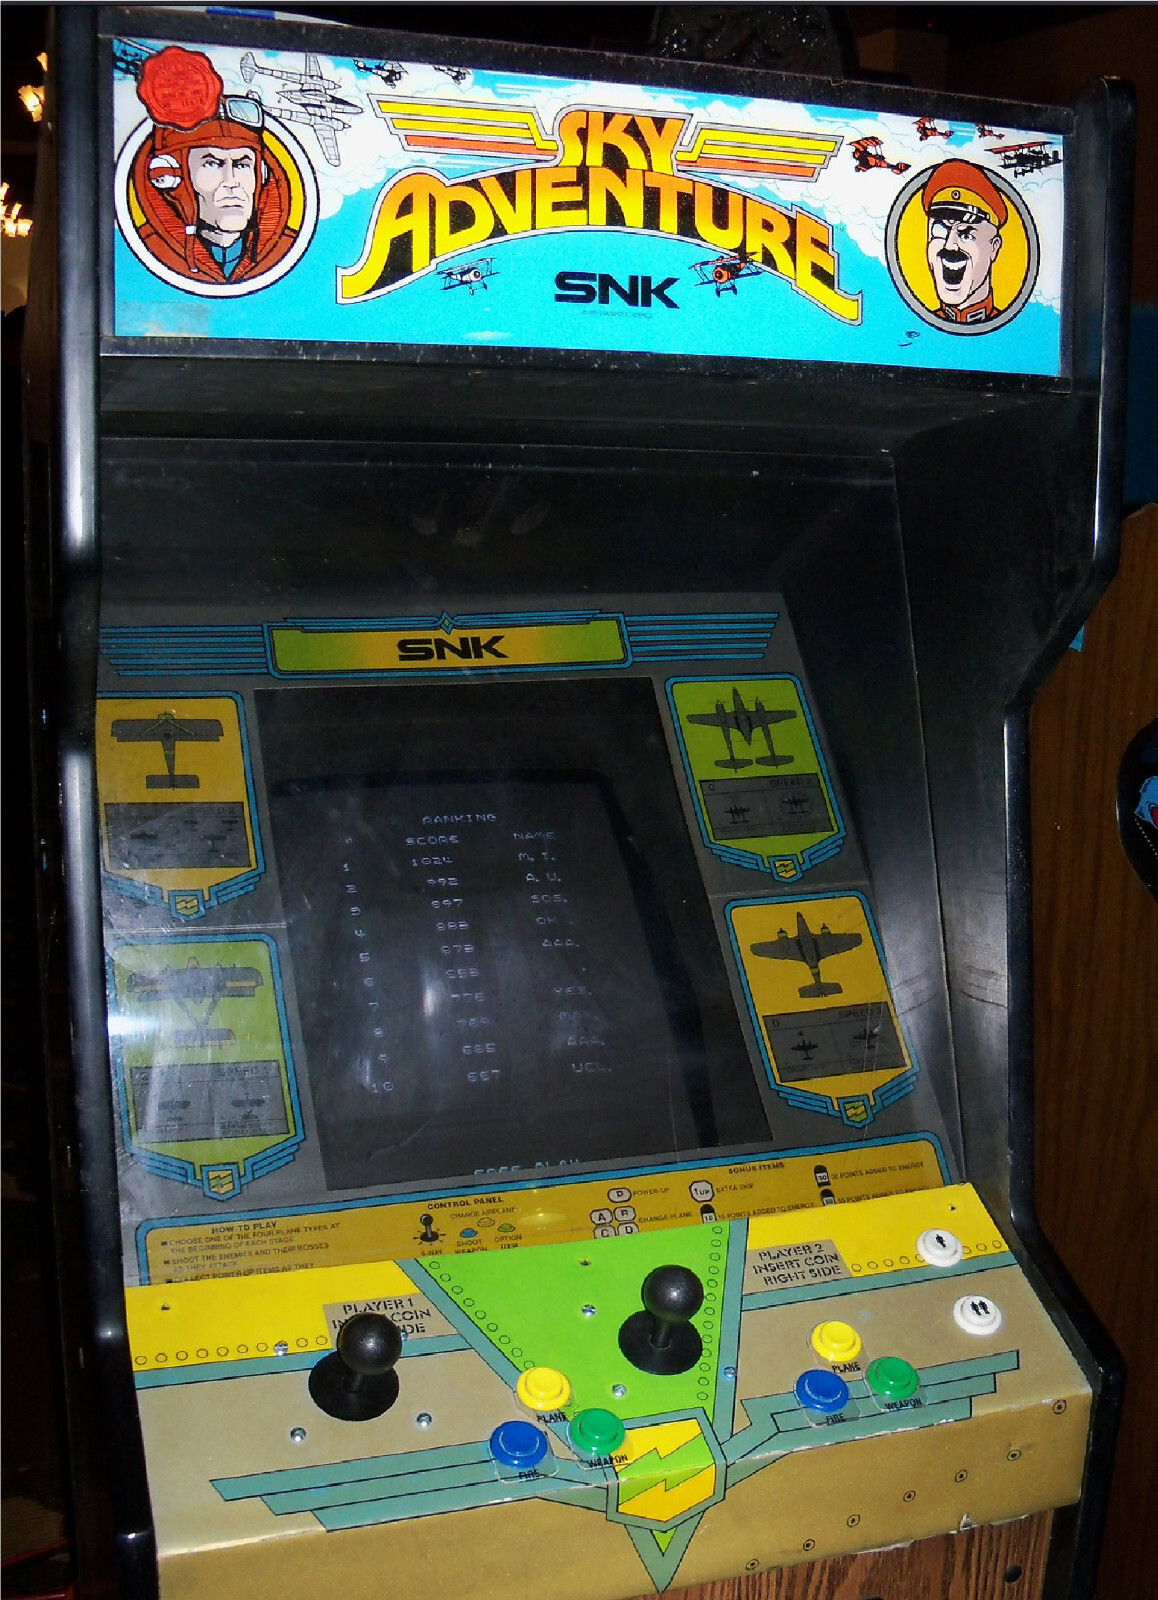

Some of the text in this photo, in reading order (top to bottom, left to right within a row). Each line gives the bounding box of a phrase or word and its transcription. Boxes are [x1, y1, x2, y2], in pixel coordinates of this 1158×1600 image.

[558, 109, 685, 176] SKY
[338, 166, 861, 324] ADVENTURE
[555, 270, 680, 309] SNK
[398, 635, 510, 662] SNK
[422, 813, 497, 825] RANKING
[404, 834, 460, 846] SCORE
[513, 831, 556, 840] NAME
[343, 862, 350, 872] 1
[345, 884, 358, 893] 2
[350, 905, 362, 917] 3
[354, 928, 365, 938] 4
[359, 952, 371, 963] 5
[363, 977, 375, 987] 6
[368, 1001, 379, 1012] 7
[728, 1162, 786, 1175] BONUS ITEMS
[840, 1170, 864, 1179] POINTS
[865, 1167, 888, 1175] ADDED
[715, 1185, 738, 1194] EXTRA
[427, 1196, 504, 1210] CONTROL PANEL
[598, 1212, 607, 1222] A
[752, 1207, 777, 1216] ADDED
[170, 1236, 204, 1246] CHOOSE
[205, 1234, 222, 1243] ONE
[224, 1234, 236, 1242] OF
[237, 1232, 251, 1241] THE
[304, 1224, 329, 1233] TYPES
[330, 1222, 341, 1230] AT
[212, 1221, 278, 1235] HOW TO PLAY
[601, 1228, 610, 1238] C
[625, 1225, 634, 1235] D
[456, 1238, 483, 1248] SHOOT
[494, 1233, 522, 1243] OPTION
[171, 1246, 186, 1255] THE
[188, 1242, 232, 1253] BEGINNING
[234, 1240, 246, 1249] OF
[246, 1238, 268, 1248] EACH
[500, 1243, 519, 1251] ITEM
[758, 1243, 825, 1261] PLAYER 2
[171, 1255, 200, 1266] SHOOT
[201, 1253, 218, 1262] THE
[219, 1250, 253, 1261] ENEMIES
[255, 1248, 271, 1257] AND
[297, 1242, 330, 1252] BOSSES
[752, 1252, 840, 1275] INSERT COIN
[763, 1264, 843, 1287] RIGHT SIDE
[343, 1297, 415, 1315] PLAYER 1
[391, 1308, 432, 1322] COIN
[831, 1361, 862, 1374] PLANE
[884, 1397, 923, 1410] WEAPON
[536, 1411, 567, 1424] PLANE
[825, 1412, 845, 1424] FIRE
[588, 1454, 629, 1468] WEAPON
